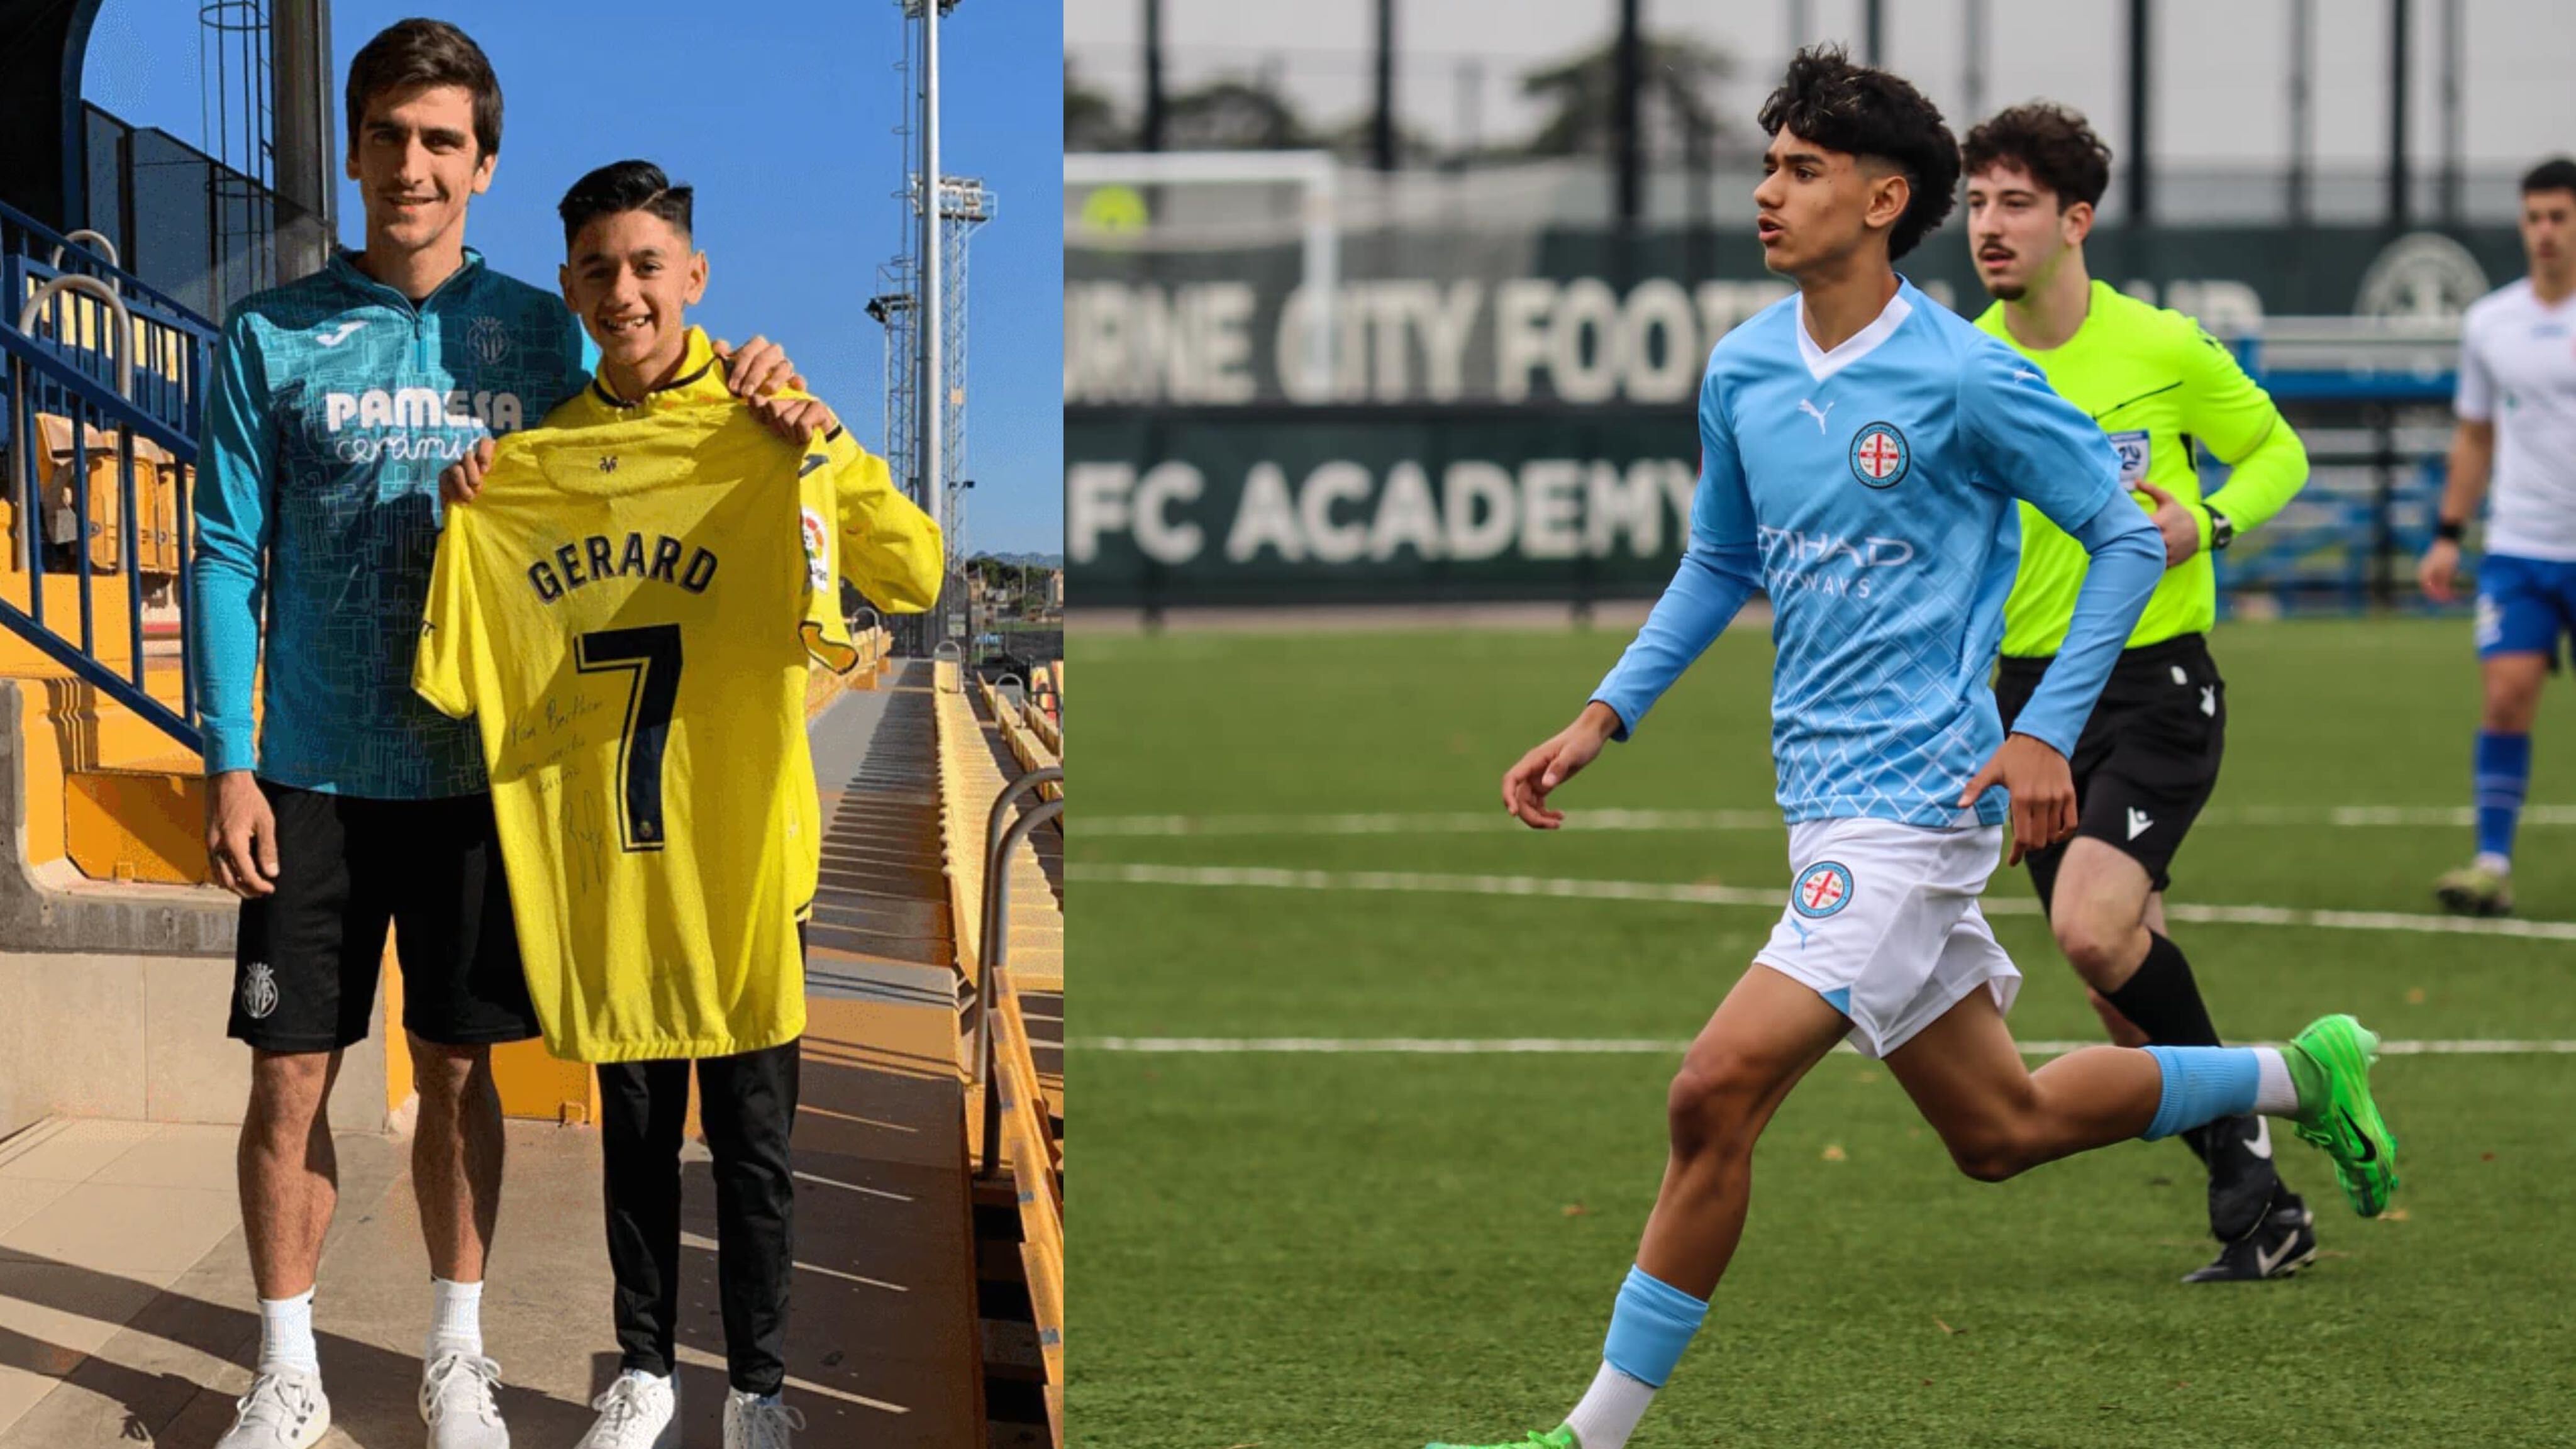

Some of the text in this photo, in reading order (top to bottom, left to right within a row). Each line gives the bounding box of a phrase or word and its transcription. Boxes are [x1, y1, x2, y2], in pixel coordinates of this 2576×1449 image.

[1277, 280, 1484, 406] CITY
[326, 387, 523, 432] PAMESA
[1067, 460, 1205, 564] FC
[527, 531, 718, 605] GERARD
[574, 622, 684, 853] 7
